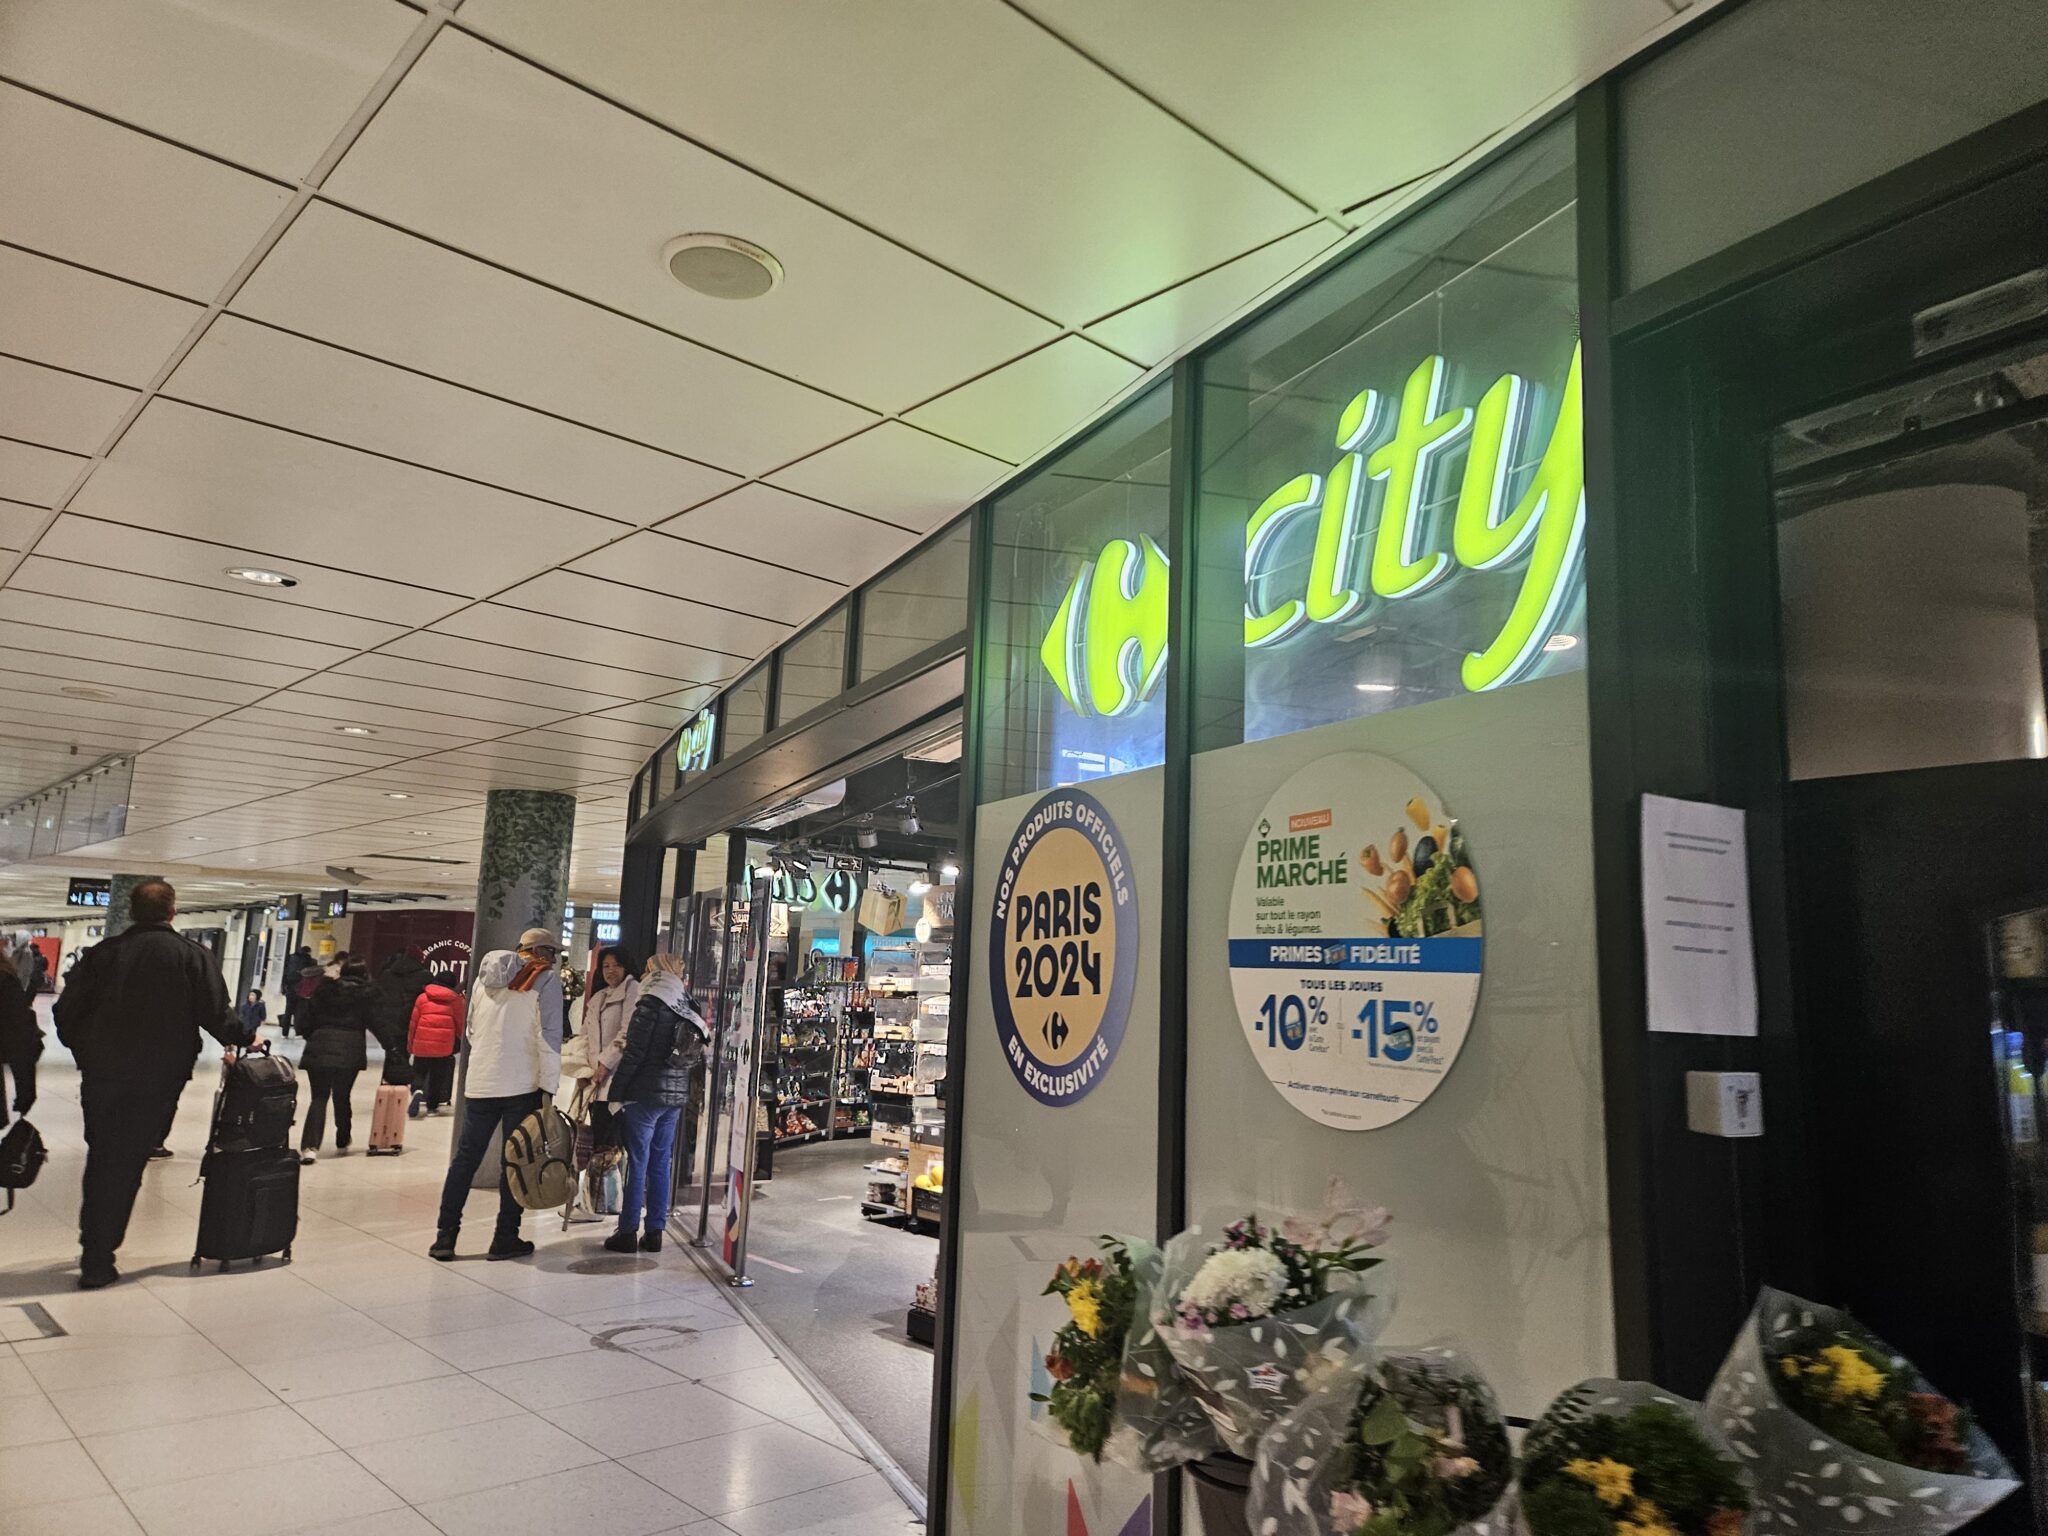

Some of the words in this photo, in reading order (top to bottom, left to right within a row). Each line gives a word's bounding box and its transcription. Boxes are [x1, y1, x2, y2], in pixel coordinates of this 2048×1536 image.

[1244, 338, 1586, 693] city
[996, 867, 1015, 919] NOS
[1011, 799, 1074, 866] PRODUITS
[1075, 803, 1129, 906] OFFICIELS
[1257, 835, 1320, 863] PRIME
[1257, 851, 1347, 888] MARCHÉ
[1015, 881, 1101, 943] PARIS
[1256, 897, 1284, 907] Valable
[1256, 912, 1268, 920] sur
[1270, 911, 1286, 920] tout
[1288, 910, 1295, 919] le
[1297, 910, 1321, 922] rayon
[1256, 924, 1276, 934] fruits
[1277, 923, 1283, 934] &
[454, 940, 473, 957] COFF
[1270, 945, 1322, 963] PRIMES
[1350, 943, 1421, 965] FIDÉLITÉ
[1015, 940, 1101, 998] 2024
[1300, 979, 1326, 990] TOUS
[1328, 980, 1346, 991] LES
[1348, 981, 1383, 992] JOURS
[1007, 1034, 1024, 1069] EN
[1023, 1035, 1109, 1098] EXCLUSIVITÉ
